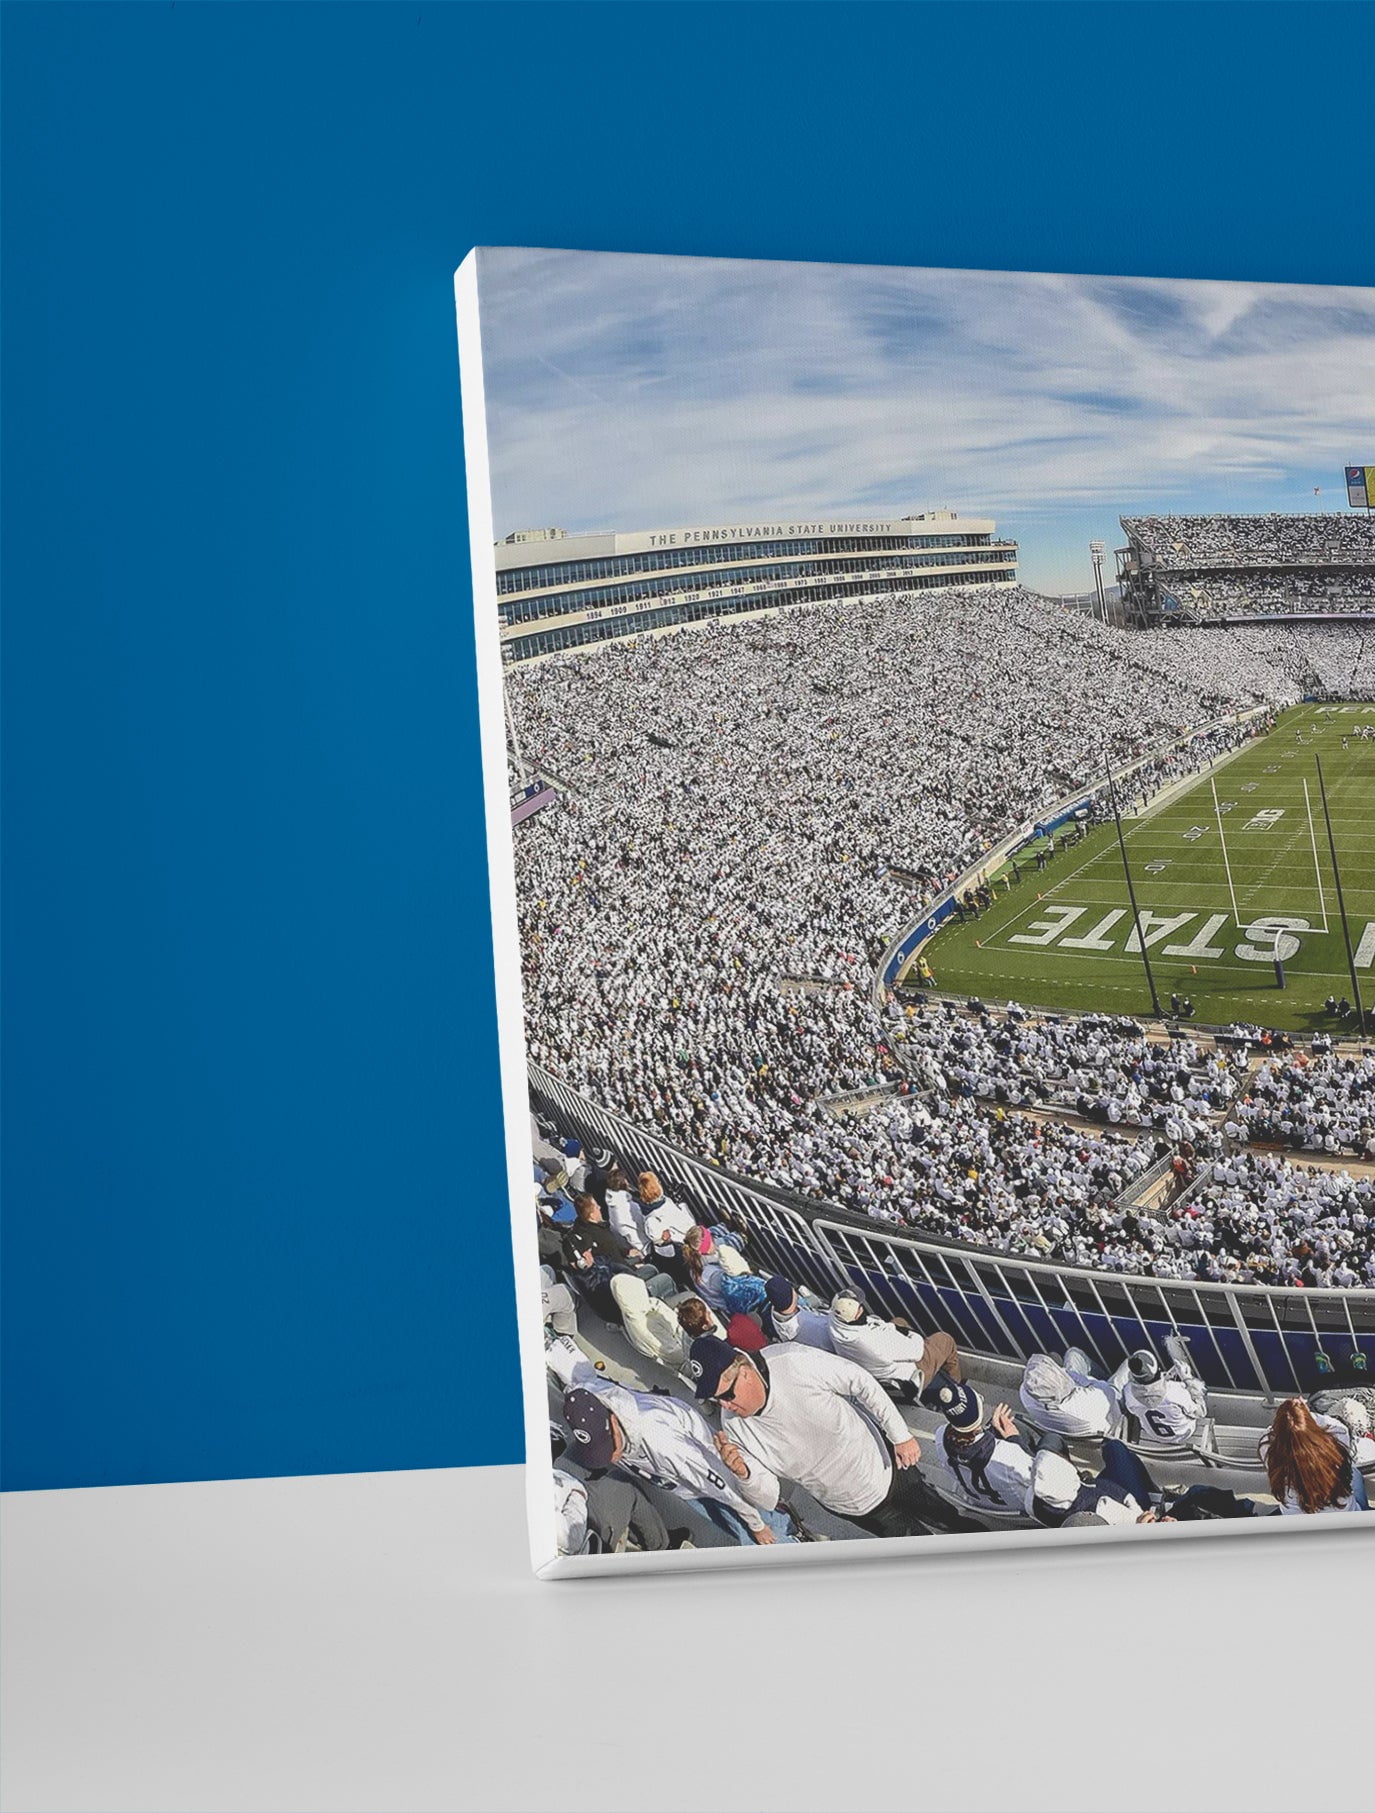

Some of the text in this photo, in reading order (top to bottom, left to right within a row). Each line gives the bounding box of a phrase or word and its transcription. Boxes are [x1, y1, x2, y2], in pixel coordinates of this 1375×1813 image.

[649, 523, 892, 546] THE PENNSYLVANIA STATE UNIVERSITY
[635, 602, 651, 611] 1911
[730, 586, 745, 594] 1947
[1006, 904, 1312, 963] STATE
[1144, 1409, 1176, 1437] 6
